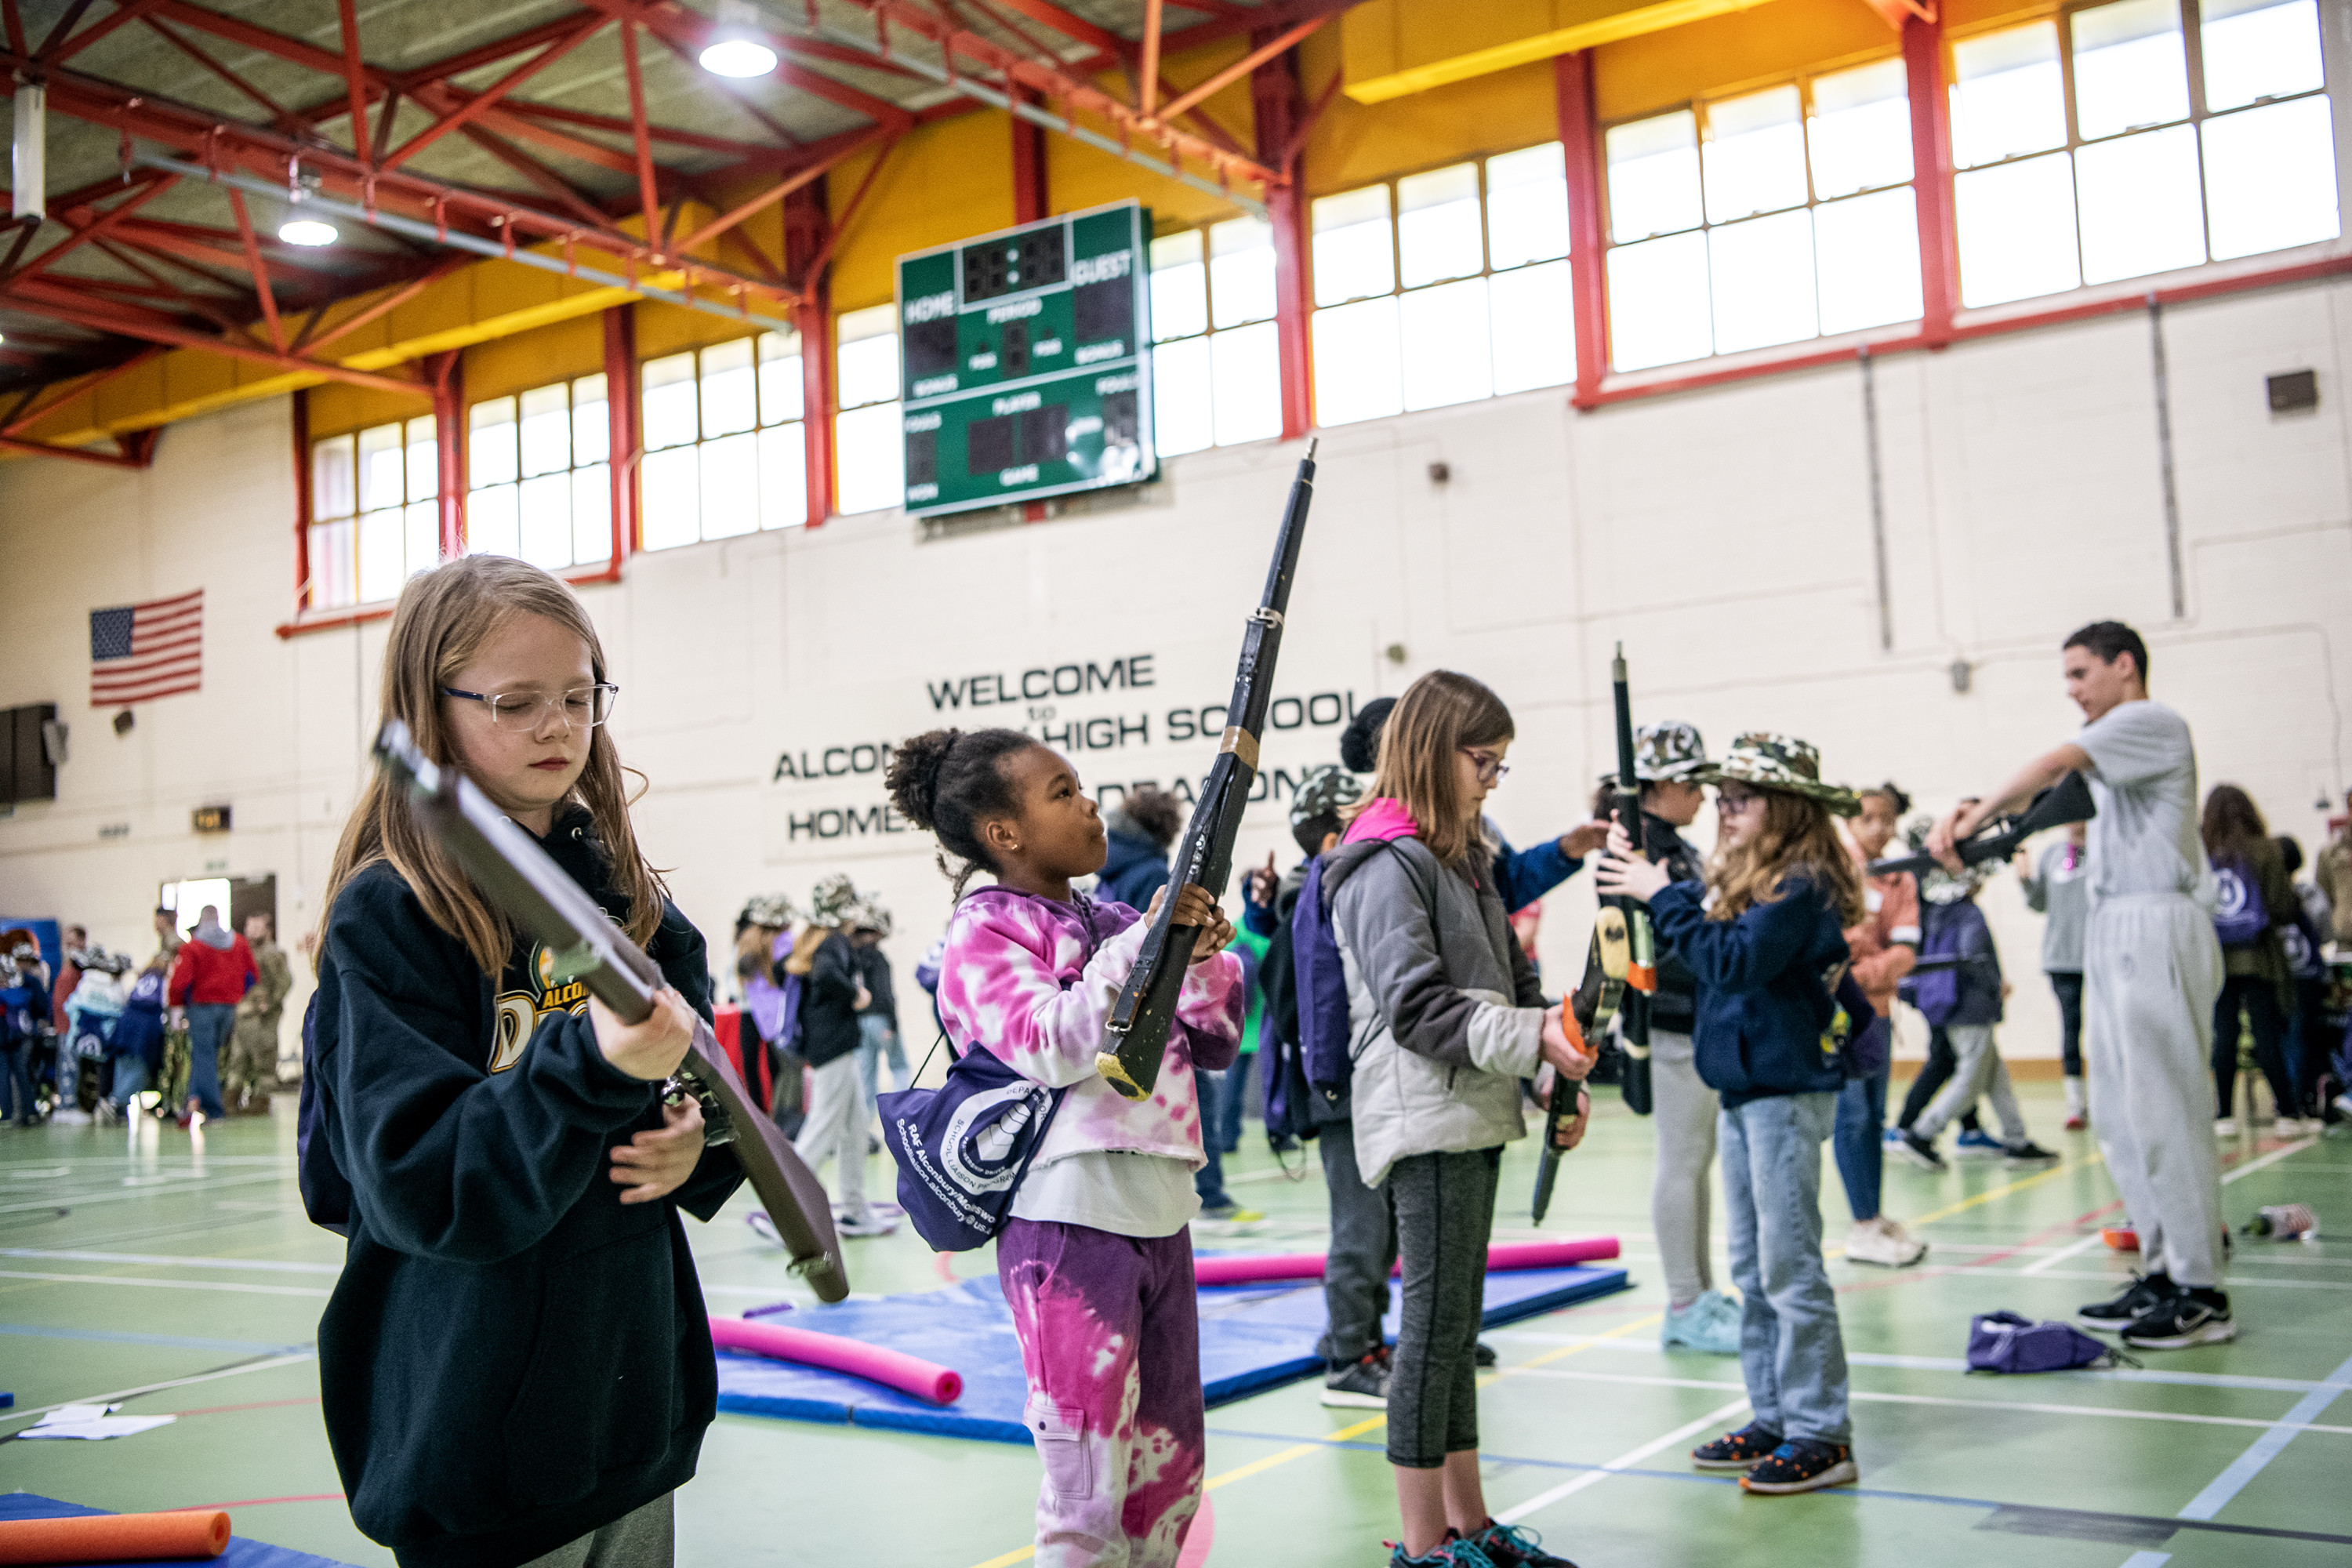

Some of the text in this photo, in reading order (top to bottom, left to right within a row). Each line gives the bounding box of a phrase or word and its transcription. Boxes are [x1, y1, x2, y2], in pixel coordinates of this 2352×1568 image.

[927, 654, 1156, 710] WELCOME
[1042, 713, 1149, 751] HIGH
[1167, 690, 1355, 742] SCOOL
[789, 804, 906, 842] HOME
[542, 981, 588, 1009] ALCO
[908, 1123, 923, 1147] RAF
[946, 1118, 965, 1157] SCHOOL
[948, 1159, 977, 1188] LIAISON
